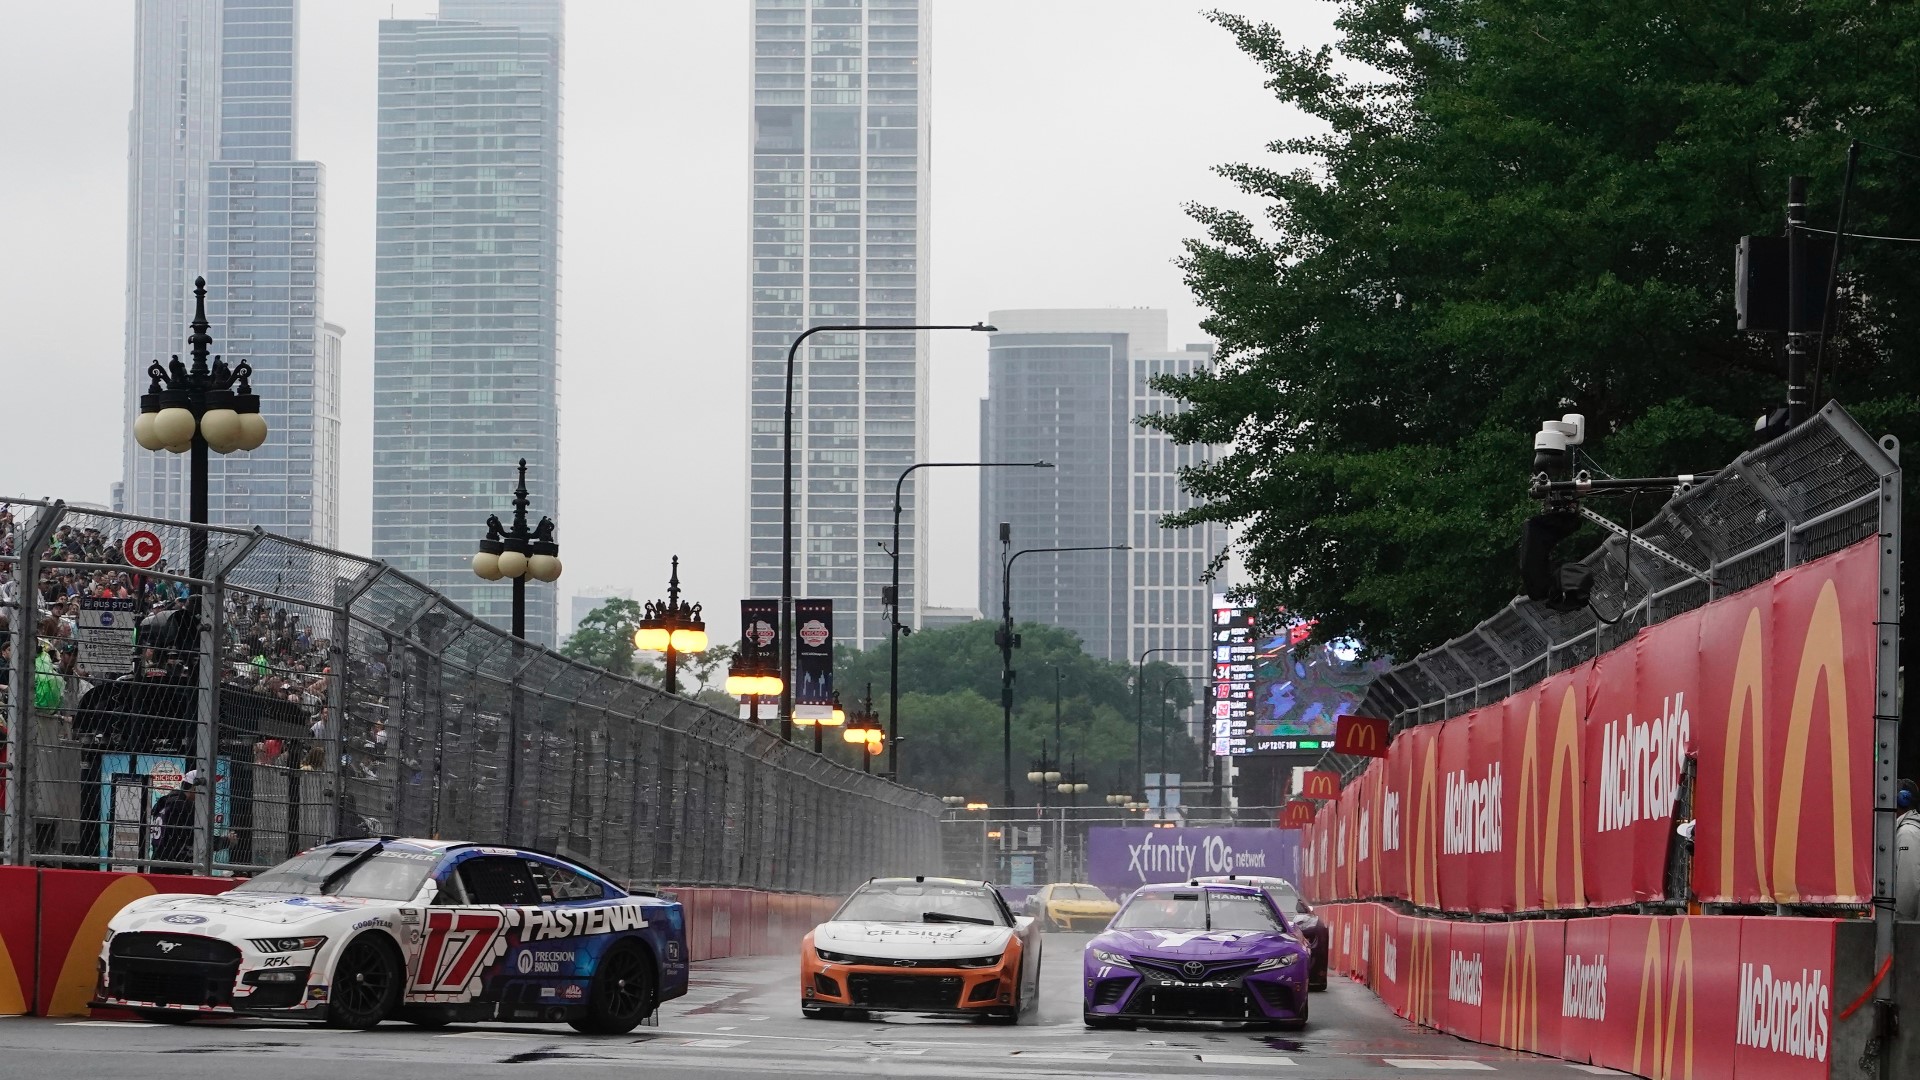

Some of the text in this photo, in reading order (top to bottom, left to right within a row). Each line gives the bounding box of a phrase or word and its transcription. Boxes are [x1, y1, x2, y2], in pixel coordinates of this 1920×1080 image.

[133, 537, 153, 562] C
[1598, 692, 1690, 832] McDnald's
[1443, 761, 1503, 855] McDnald's
[373, 851, 436, 861] ESCHER
[1128, 832, 1197, 882] xfinity
[1203, 835, 1233, 874] 10G
[1236, 850, 1266, 868] network
[352, 917, 393, 931] GOODYEAR
[521, 905, 648, 942] FASTENAL
[263, 956, 293, 967] RFK
[414, 911, 502, 989] 17
[535, 951, 575, 962] PRECISION
[534, 962, 558, 972] BRAND
[1097, 966, 1112, 978] 11
[1160, 980, 1229, 988] CAMRY
[1562, 954, 1607, 1022] McDonald's
[1737, 963, 1829, 1062] McDonald's
